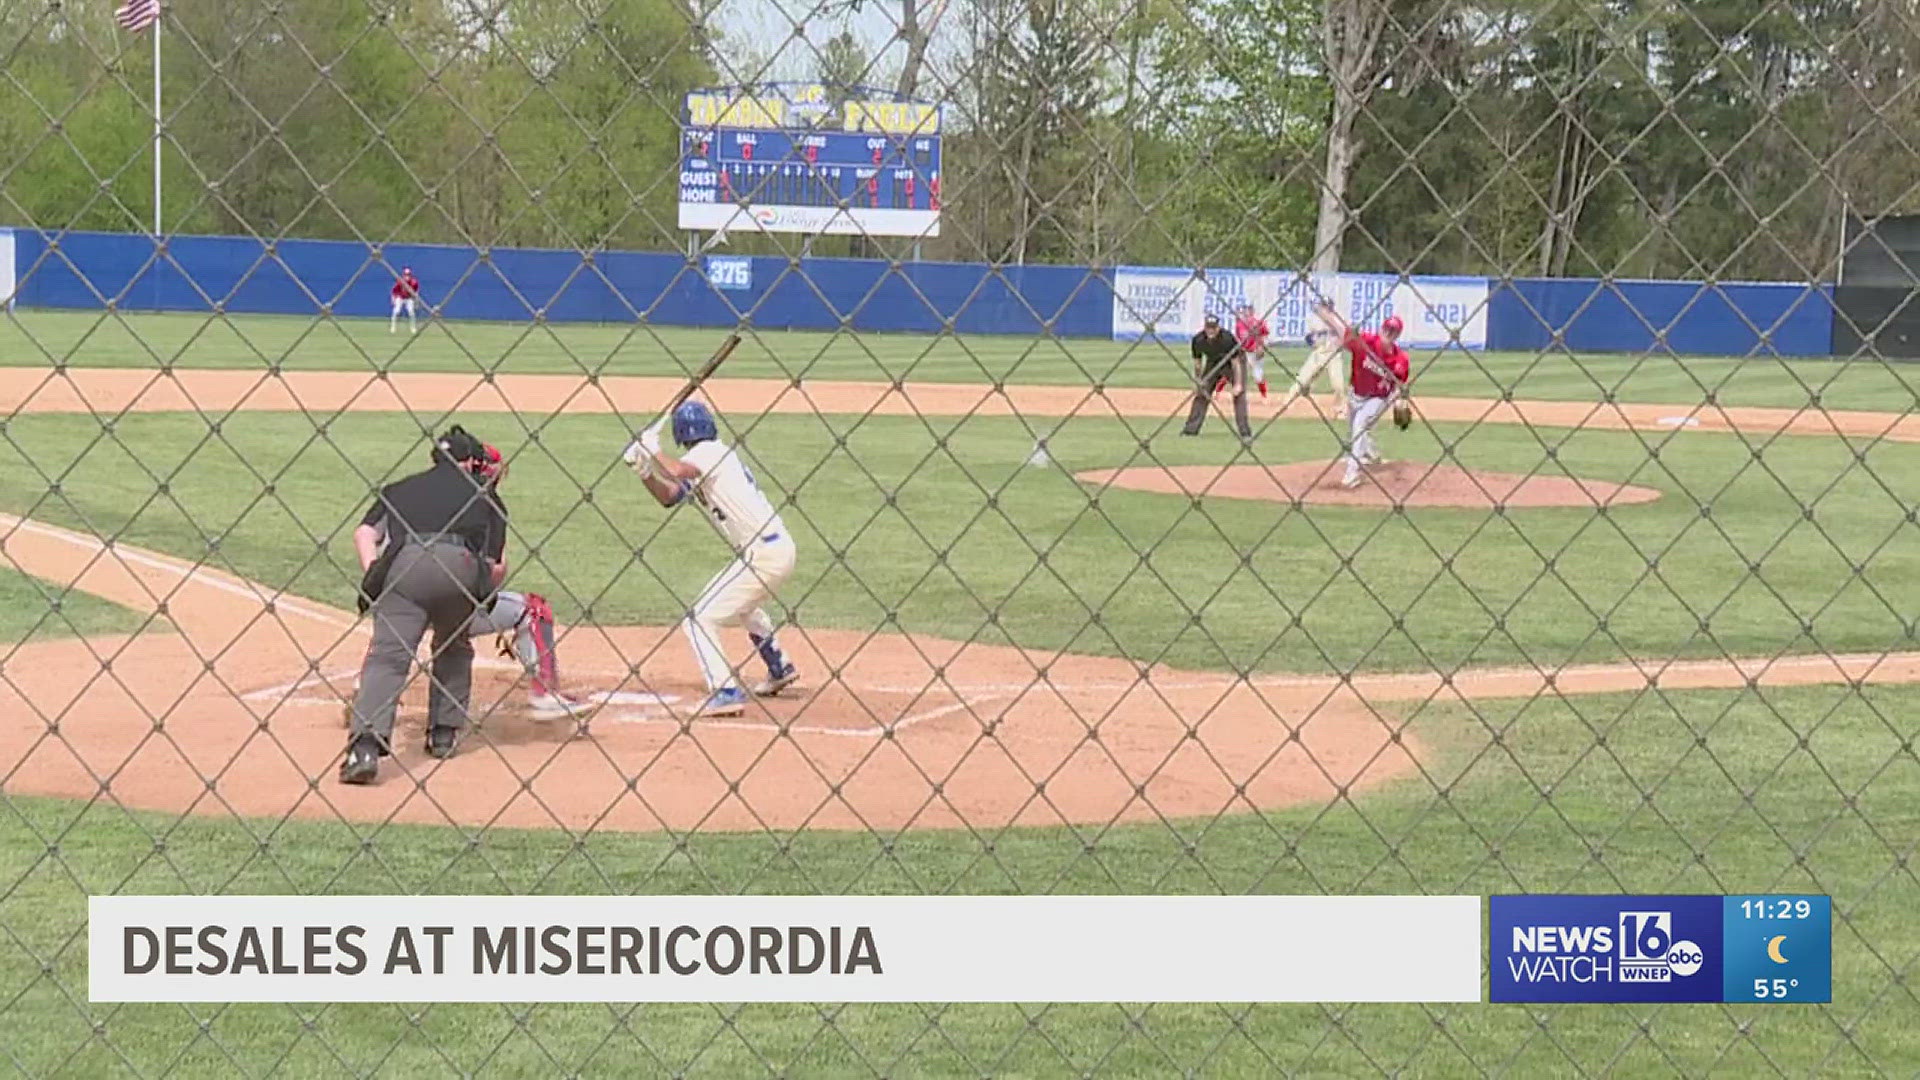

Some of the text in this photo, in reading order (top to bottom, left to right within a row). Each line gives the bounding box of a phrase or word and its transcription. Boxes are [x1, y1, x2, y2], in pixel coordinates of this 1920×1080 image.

[845, 101, 938, 133] FIELD
[866, 138, 885, 150] OUT
[680, 171, 717, 186] GUEST
[681, 188, 716, 202] HOME
[710, 261, 749, 284] 375
[1424, 303, 1468, 323] 2021
